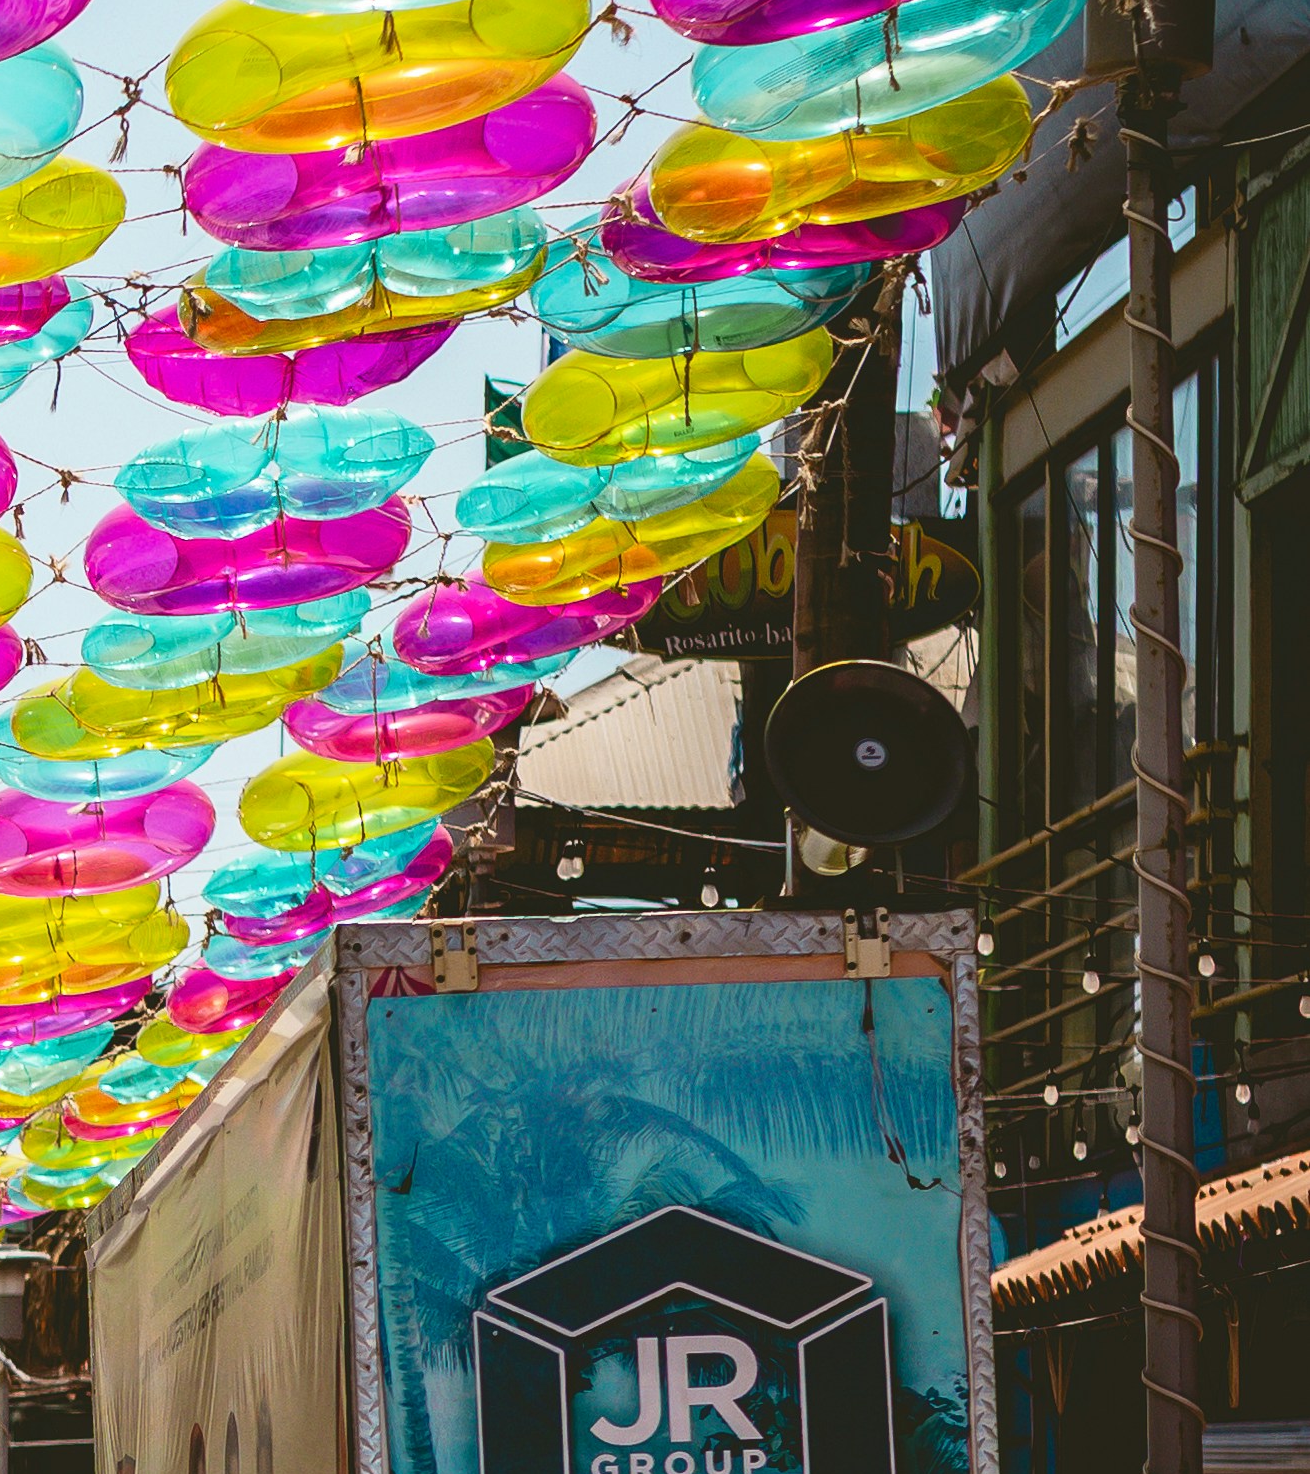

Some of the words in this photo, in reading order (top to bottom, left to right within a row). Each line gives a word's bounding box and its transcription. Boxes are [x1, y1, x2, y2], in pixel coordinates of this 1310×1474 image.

[665, 624, 756, 655] Rosarito
[766, 623, 792, 645] ba
[590, 1335, 764, 1446] JR
